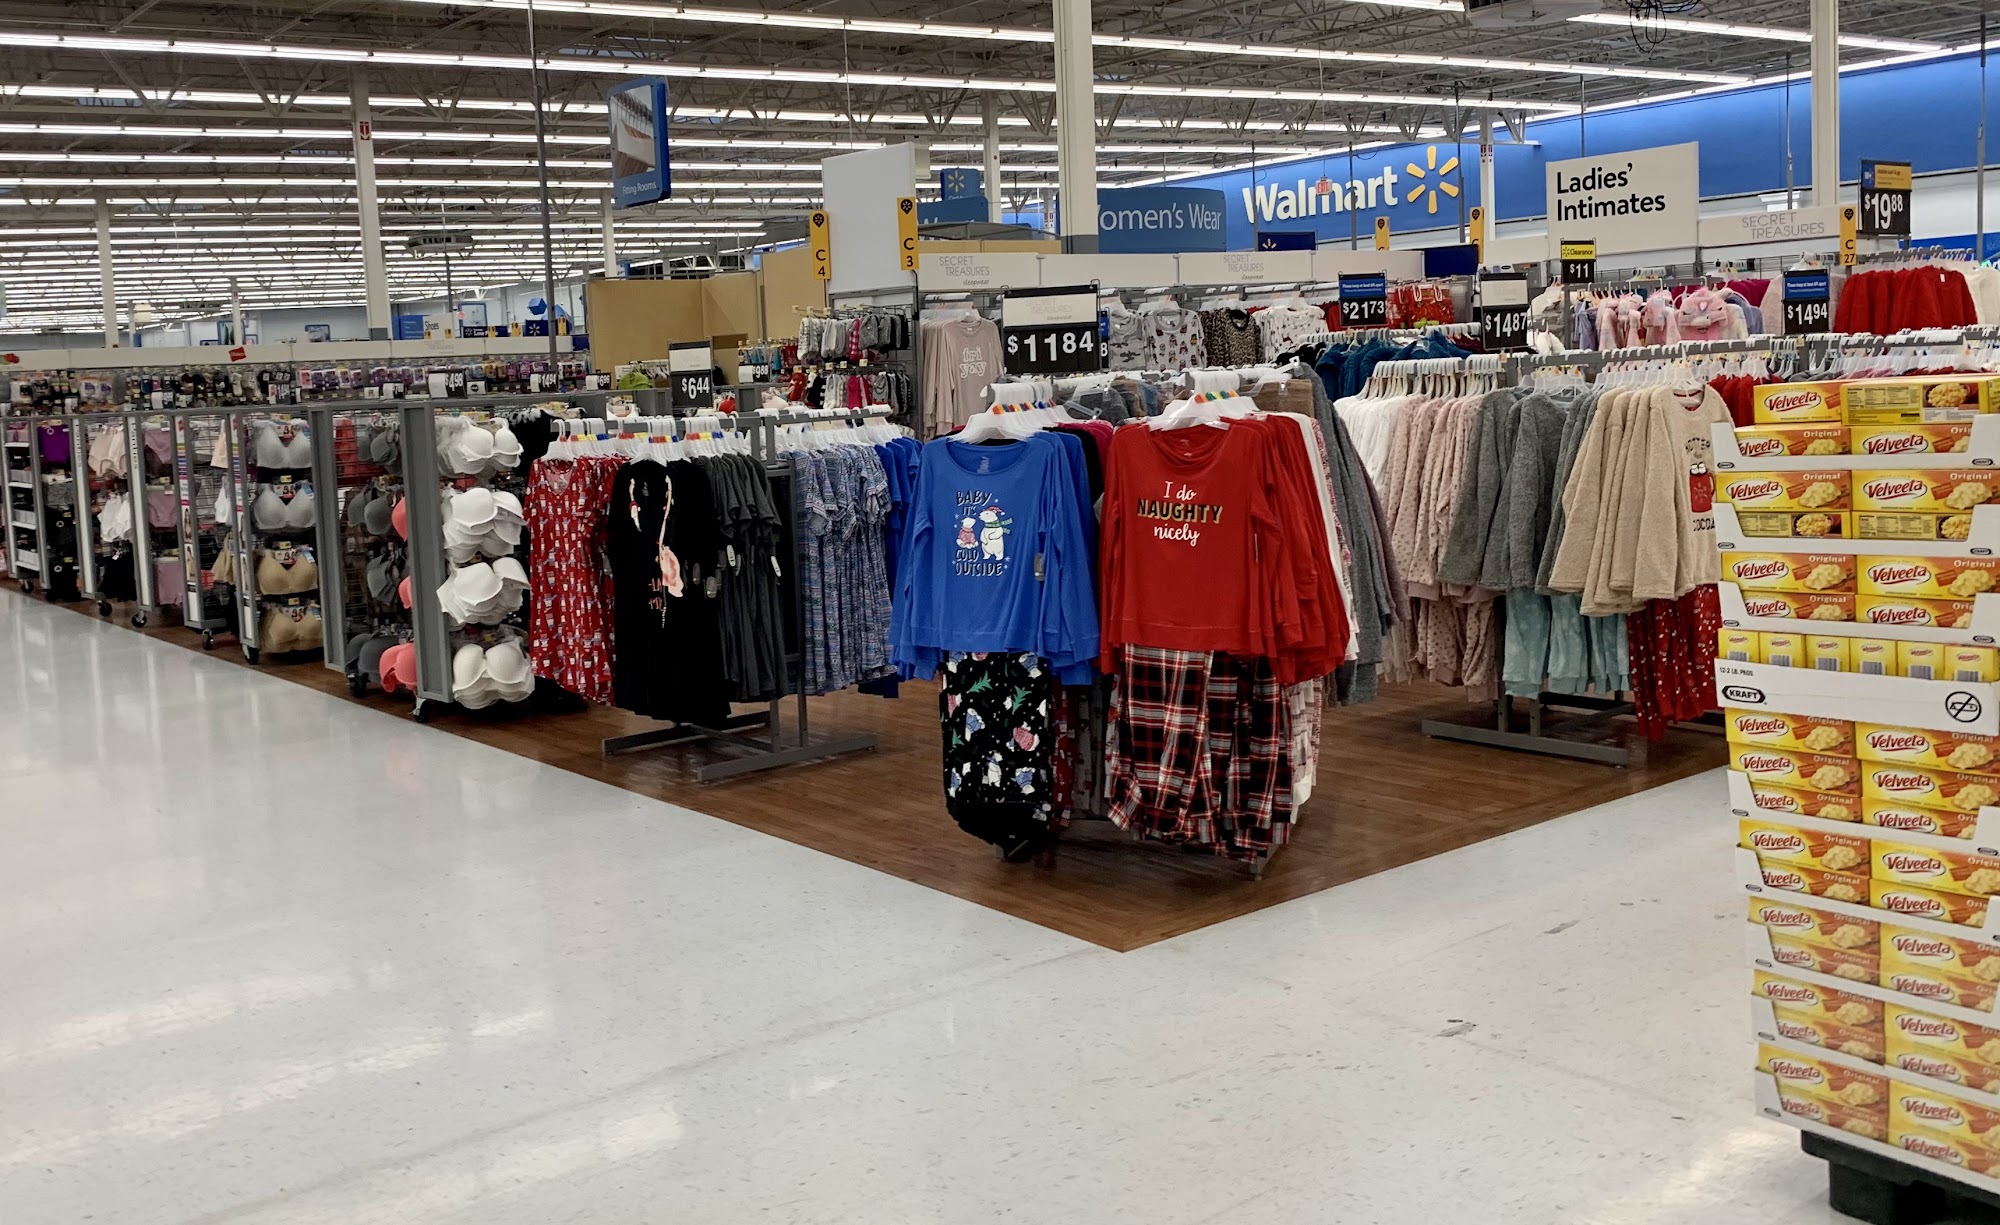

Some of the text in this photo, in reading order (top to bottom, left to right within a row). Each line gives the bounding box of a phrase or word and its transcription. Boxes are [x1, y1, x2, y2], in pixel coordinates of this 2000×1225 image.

[1556, 162, 1633, 194] Ladies'
[637, 181, 657, 192] Rooms
[1317, 181, 1330, 194] EXIT
[1242, 165, 1398, 225] Walmart
[1556, 193, 1666, 222] Intimates
[1098, 202, 1221, 231] omen's Wear
[1742, 211, 1797, 229] SECRET
[1750, 222, 1825, 241] TREASURES
[903, 237, 915, 251] C
[1845, 239, 1854, 250] C
[815, 249, 827, 262] C
[1223, 253, 1250, 264] SECRET
[1570, 248, 1594, 256] Clearance
[1844, 253, 1856, 264] 27
[906, 255, 915, 268] 3
[938, 255, 974, 267] SECRET
[817, 266, 826, 278] 4
[945, 265, 990, 277] TREASURES
[1570, 262, 1589, 279] $11
[963, 278, 990, 286] sleepwear
[425, 321, 439, 331] Shoes
[963, 346, 983, 362] fri
[959, 361, 987, 379] yay
[1768, 391, 1818, 411] Velveeta
[1803, 430, 1841, 438] Original
[1868, 434, 1924, 455] Velveeta
[1803, 473, 1841, 481] Original
[1949, 472, 1992, 481] Original
[1163, 480, 1197, 501] I do
[1730, 480, 1780, 499] Velveeta
[1868, 480, 1923, 498] Velveeta
[956, 490, 993, 507] BABY
[1137, 498, 1223, 524] NAUGHTY
[1153, 523, 1201, 547] nicely
[1808, 555, 1846, 563] Original
[1953, 560, 1996, 568] Original
[955, 562, 1004, 577] OUTSIDE
[1736, 561, 1785, 578] Velveeta
[1873, 565, 1927, 583] Velveeta
[1809, 595, 1847, 603] Original
[1872, 607, 1927, 624] Velveeta
[1729, 689, 1758, 700] KRAFT
[1739, 718, 1786, 732] Velveeta
[1808, 716, 1843, 726] Original
[1871, 734, 1926, 749] Velveeta
[1952, 732, 1994, 743] Original
[1743, 755, 1791, 769] Velveeta
[1813, 755, 1850, 765] Original
[1877, 774, 1931, 788] Velveeta
[1957, 773, 1998, 784] Original
[1817, 793, 1853, 805] Original
[1878, 813, 1932, 827] Velveeta
[1754, 834, 1801, 848] Velveeta
[1824, 834, 1860, 847] Original
[1887, 855, 1942, 870] Velveeta
[1823, 873, 1860, 885] Original
[1886, 896, 1941, 911] Velveeta
[1763, 910, 1811, 924] Velveeta
[1896, 938, 1952, 954] Velveeta
[1766, 984, 1816, 999] Velveeta
[1895, 978, 1951, 995] Velveeta
[1900, 1017, 1956, 1035] Velveeta
[1772, 1061, 1821, 1078] Velveeta
[1902, 1057, 1958, 1075] Velveeta
[1905, 1099, 1961, 1119] Velveeta
[1904, 1137, 1959, 1158] Velveeta
